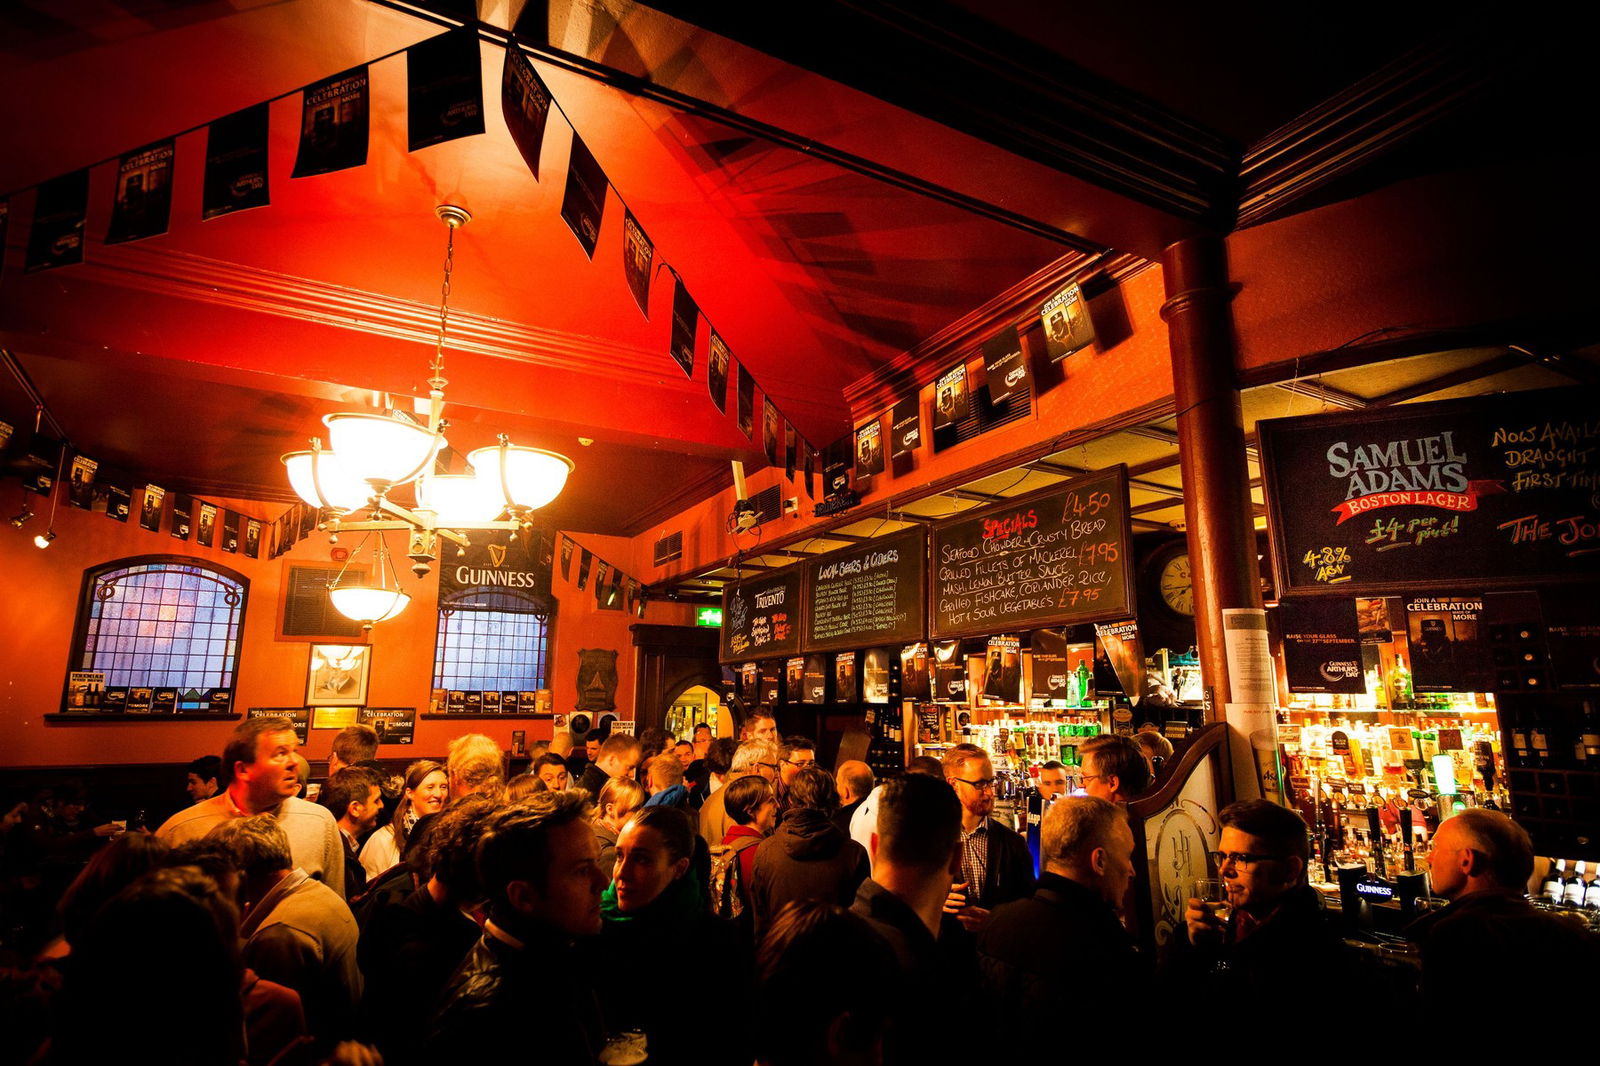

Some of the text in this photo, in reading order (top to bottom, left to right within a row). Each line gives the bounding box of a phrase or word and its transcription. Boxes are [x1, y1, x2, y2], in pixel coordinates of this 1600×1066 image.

[1491, 425, 1537, 448] NOW
[1326, 431, 1467, 478] SAMUEL
[1504, 448, 1598, 470] DRAUGHT
[1344, 463, 1469, 501] ADAMS
[1512, 469, 1567, 495] FIRST
[1347, 492, 1472, 515] BOSTON LAGER
[981, 509, 1038, 539] SPECIALS
[1496, 513, 1553, 545] THE
[941, 544, 980, 564] SEAFOOD
[982, 536, 1022, 555] CHOWDER
[1070, 518, 1107, 540] BREAD
[839, 559, 862, 577] BEERS
[939, 566, 972, 581] GRILLED
[975, 560, 1009, 575] FILLETS
[1012, 553, 1027, 568] OF
[1303, 546, 1351, 569] 4.8%
[455, 565, 535, 588] GUINNESS
[969, 577, 993, 590] LEMON
[1019, 574, 1075, 596] CORIANDER
[948, 612, 966, 625] HOT
[973, 607, 997, 621] SOUR
[1406, 602, 1483, 612] CELEBRATION
[987, 640, 1020, 648] CELEBRATION
[1356, 882, 1392, 896] GUINNESS
